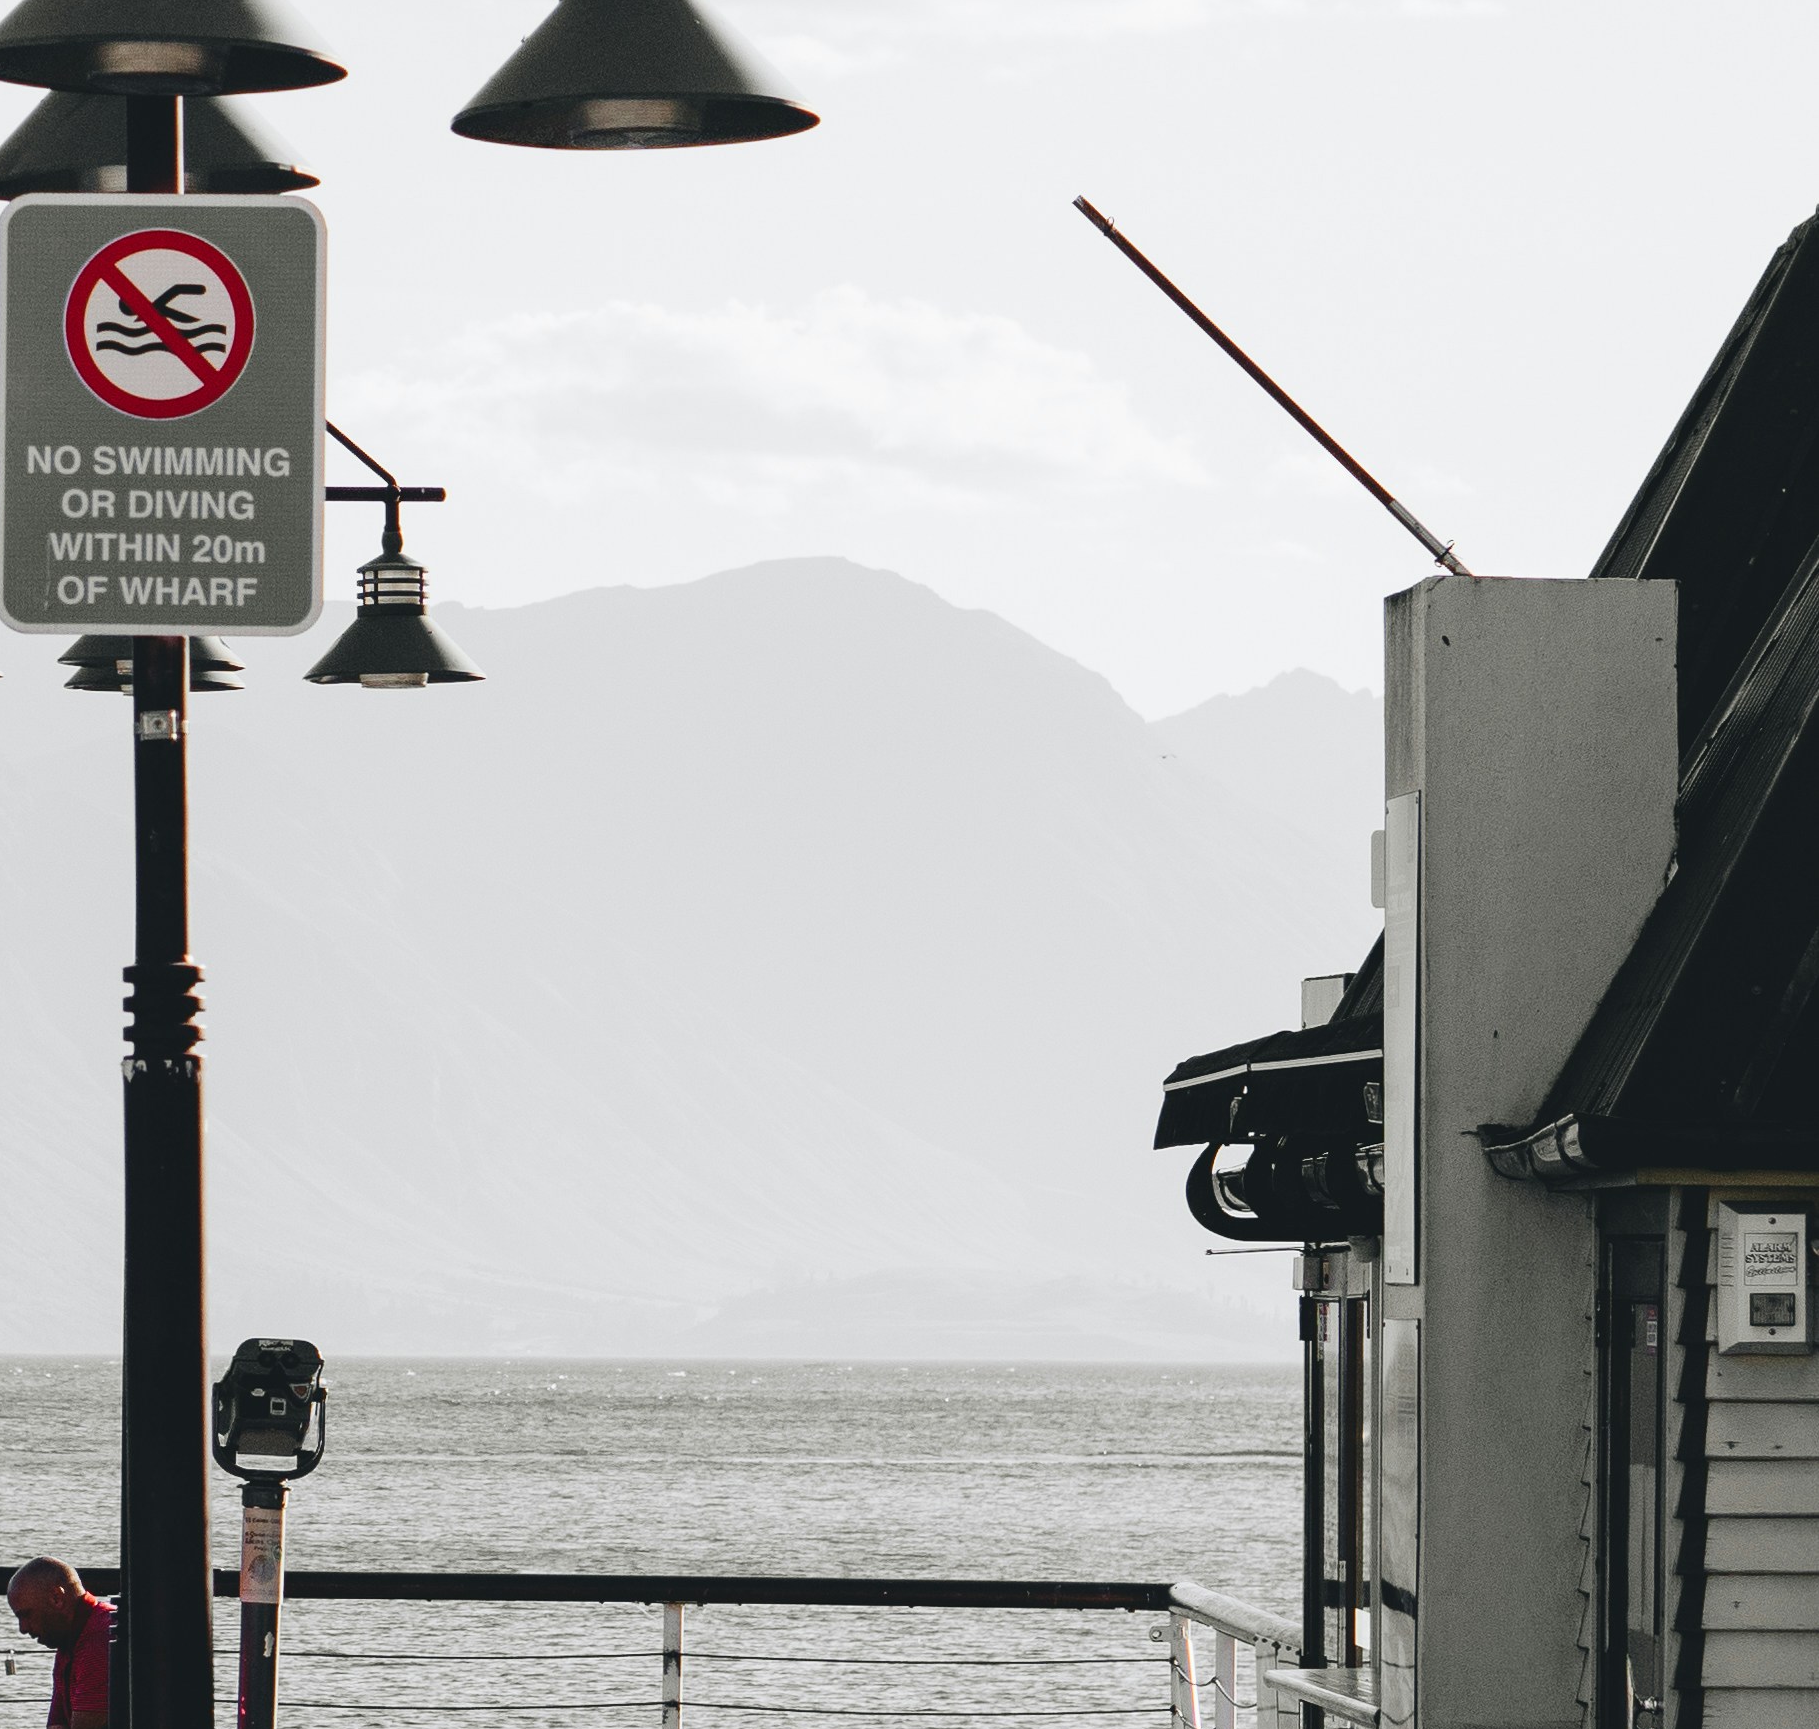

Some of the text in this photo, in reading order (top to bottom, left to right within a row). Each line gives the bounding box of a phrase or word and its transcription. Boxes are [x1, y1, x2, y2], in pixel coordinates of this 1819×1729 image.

[27, 445, 291, 477] NO SWIMMING
[62, 488, 255, 520] OR DIVING
[49, 532, 266, 564] WITHIN 20m
[57, 575, 258, 606] OF WHARF
[1744, 1253, 1797, 1263] SYSTEMS
[1749, 1242, 1792, 1252] ALARM
